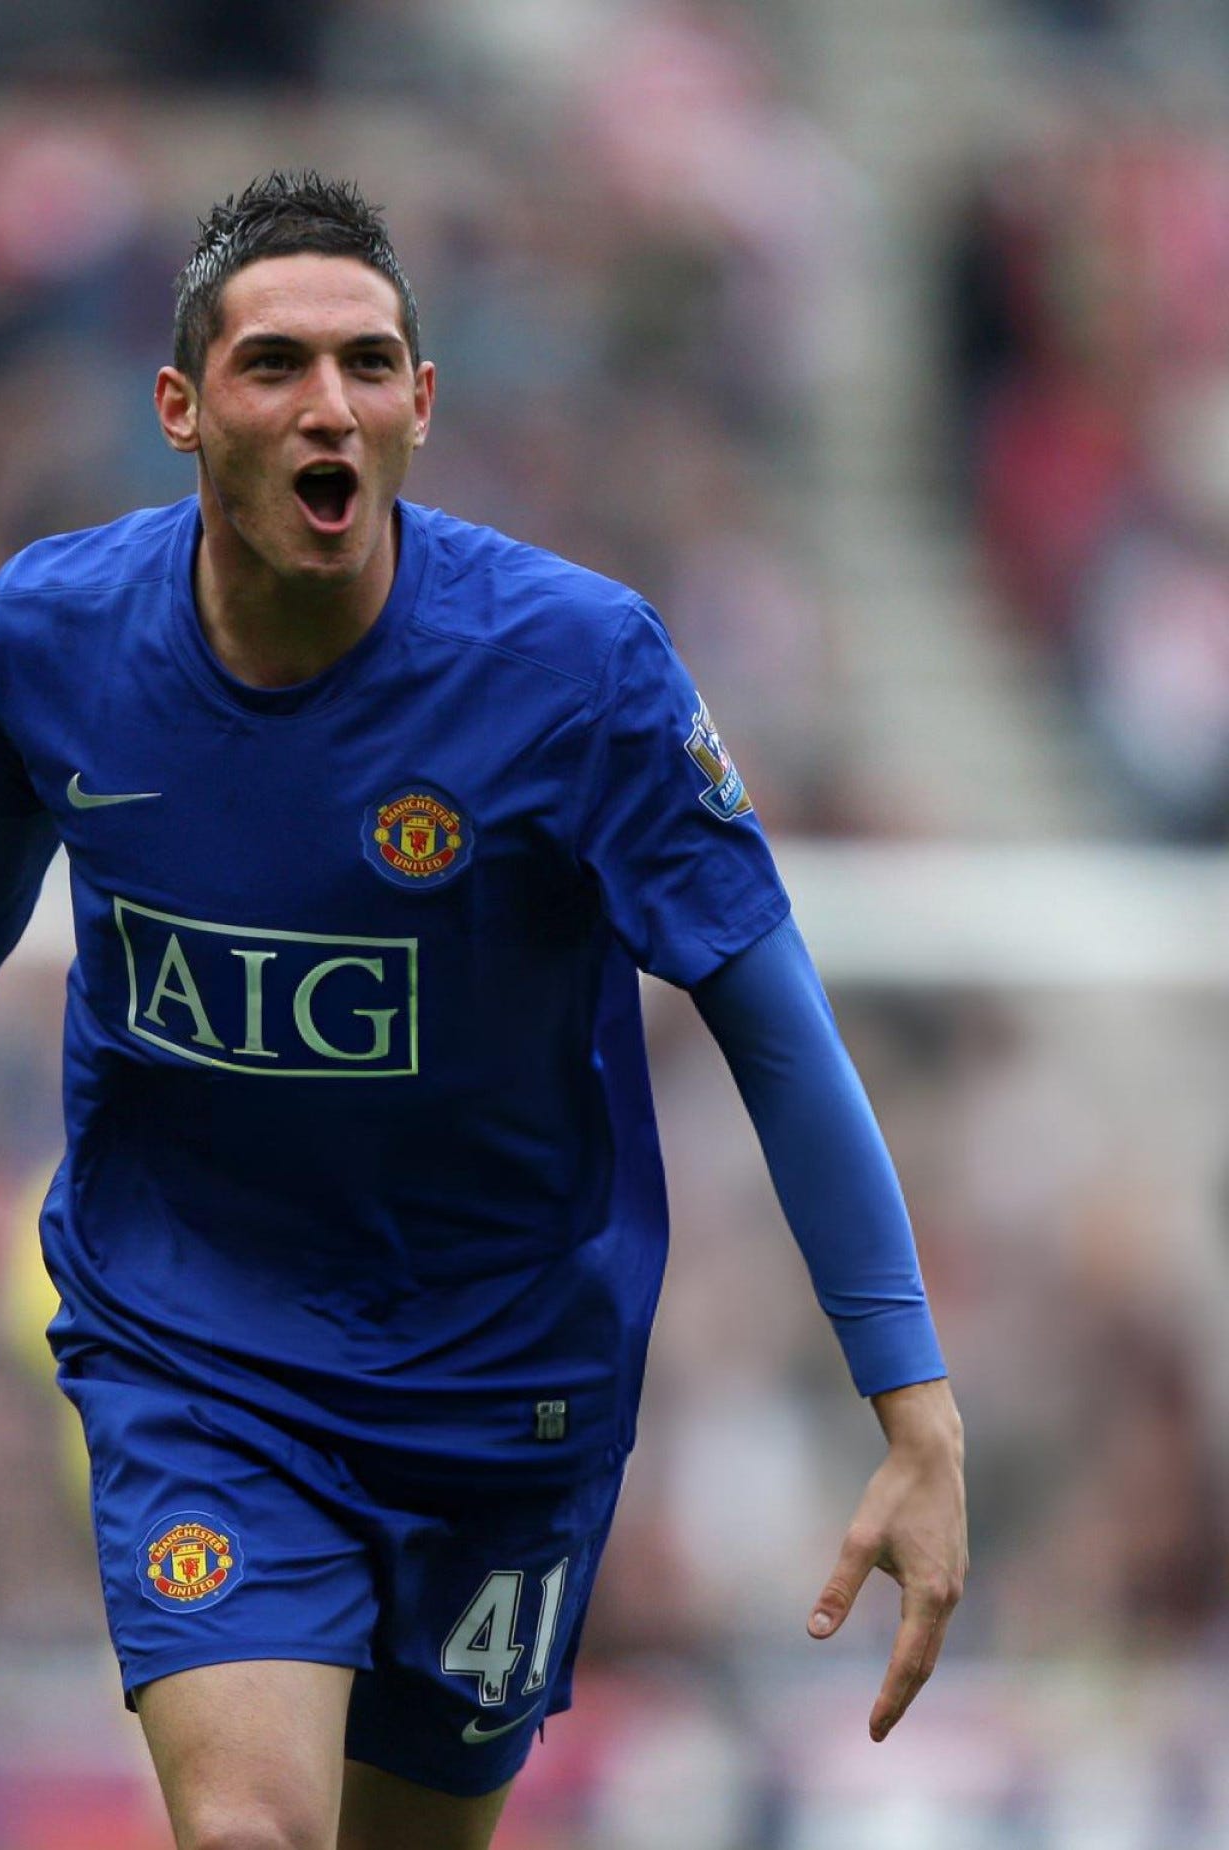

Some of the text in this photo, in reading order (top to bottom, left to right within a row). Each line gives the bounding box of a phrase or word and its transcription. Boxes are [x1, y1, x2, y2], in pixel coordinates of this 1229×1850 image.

[384, 800, 452, 829] MANCHESTER
[393, 855, 443, 870] UNITED
[143, 932, 399, 1060] AIG
[154, 1528, 223, 1557] MANCHESTER
[167, 1579, 216, 1596] UNITED
[441, 1557, 568, 1706] 41
